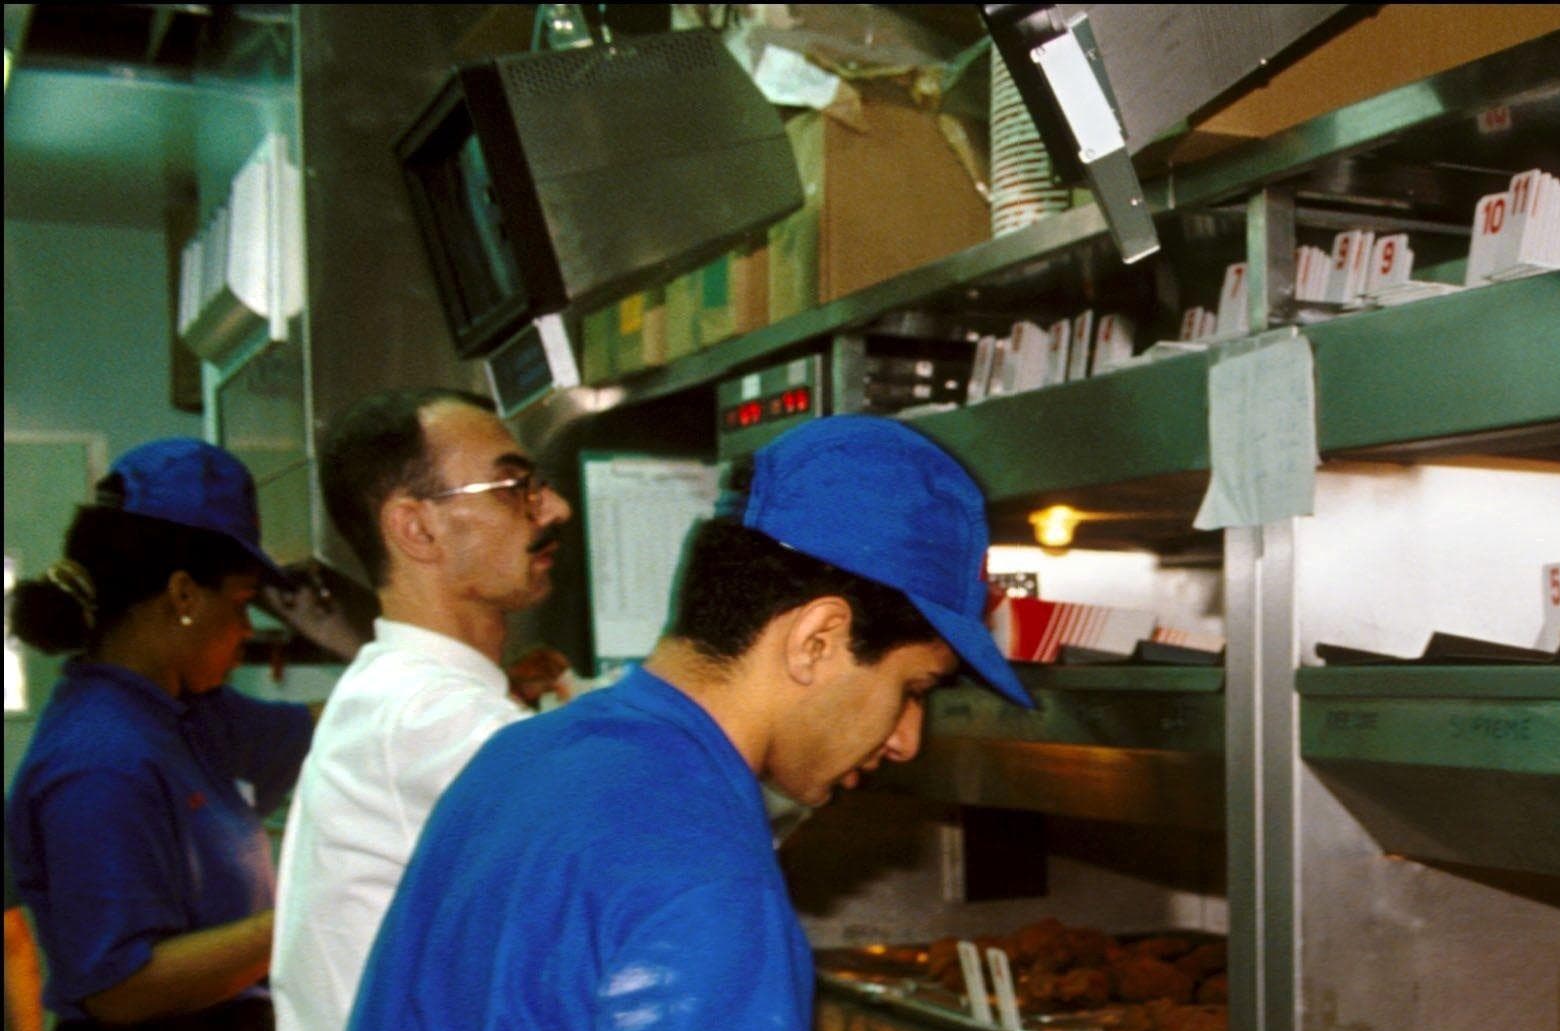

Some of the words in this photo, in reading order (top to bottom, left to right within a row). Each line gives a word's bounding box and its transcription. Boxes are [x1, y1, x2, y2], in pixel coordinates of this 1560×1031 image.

[1511, 175, 1531, 217] 11
[1482, 198, 1506, 236] 10
[1336, 236, 1350, 271] 9
[1380, 240, 1396, 276] 9
